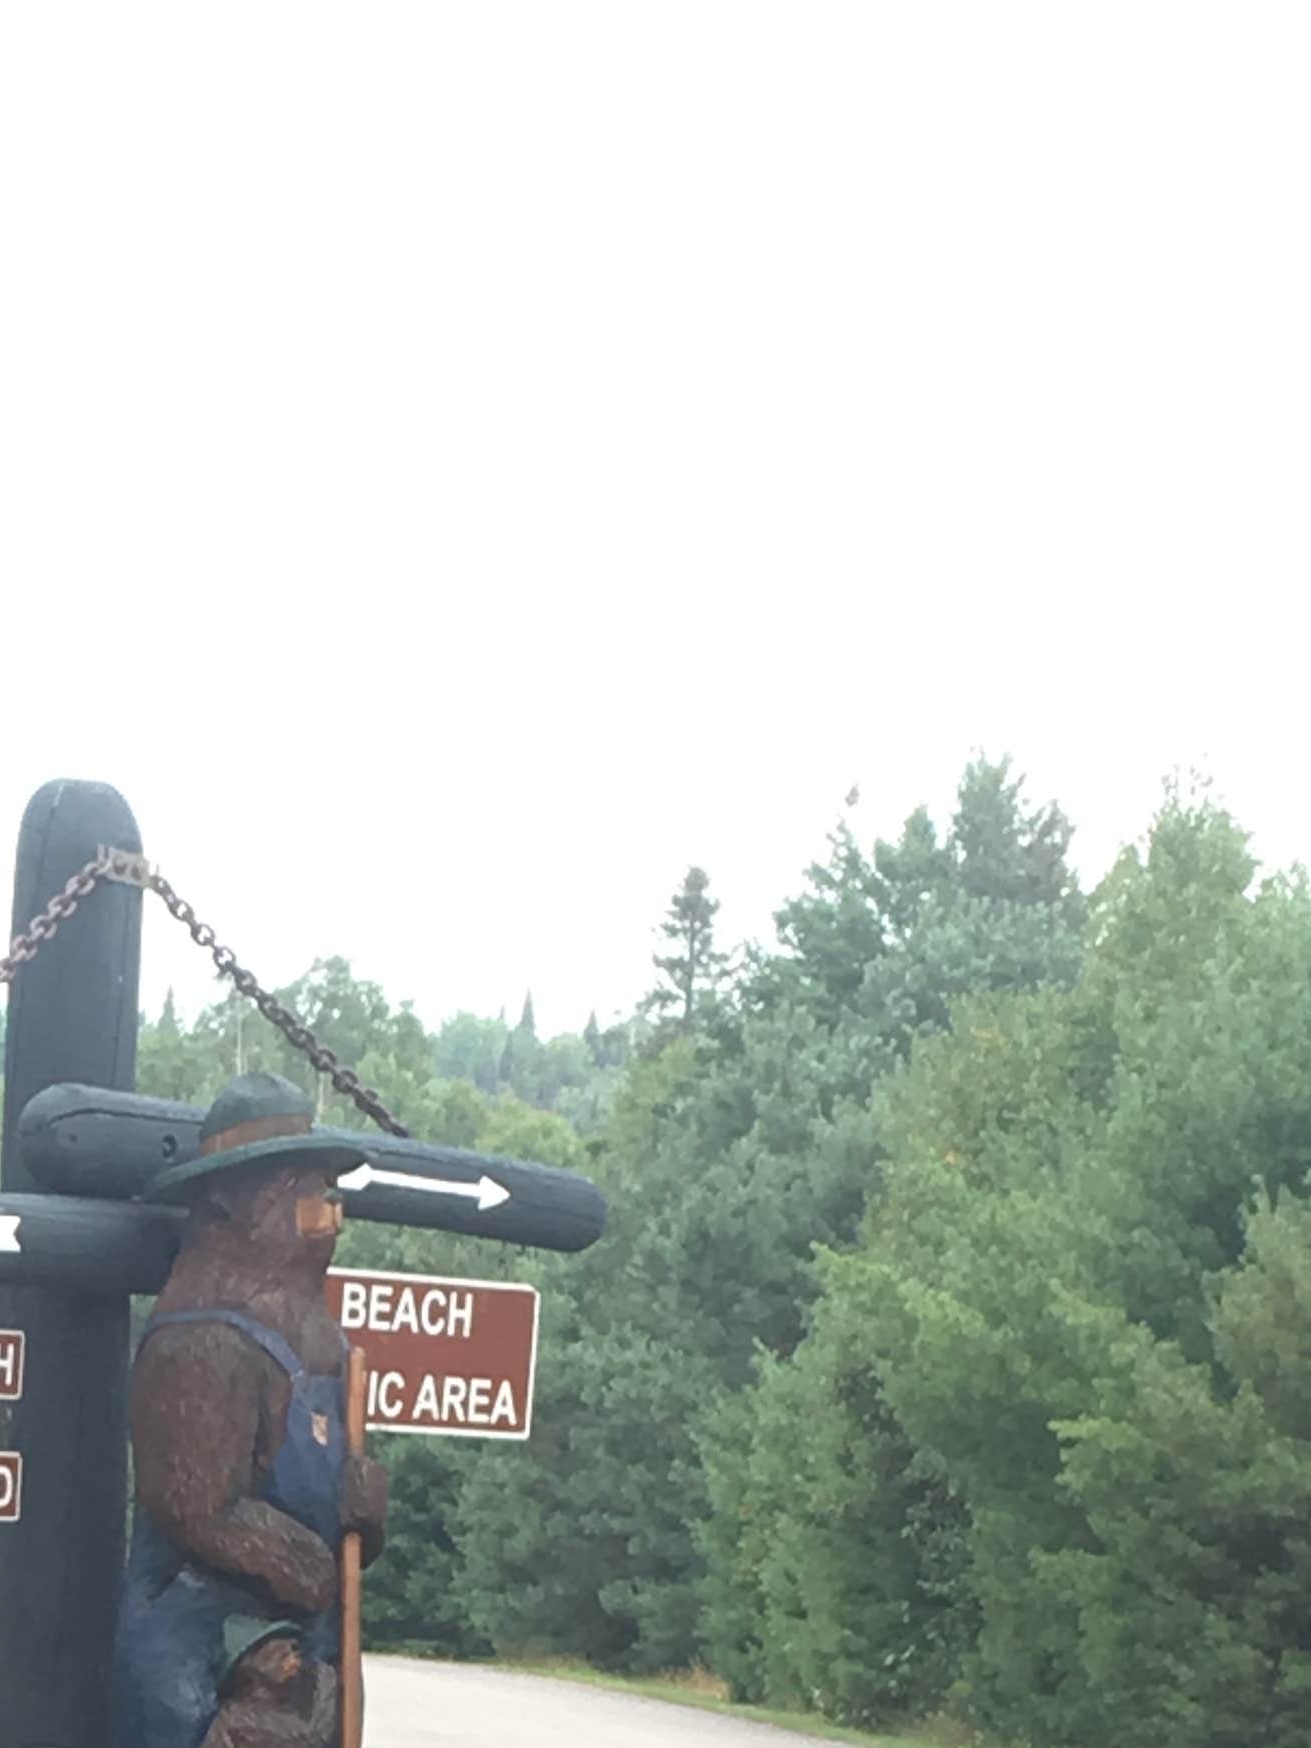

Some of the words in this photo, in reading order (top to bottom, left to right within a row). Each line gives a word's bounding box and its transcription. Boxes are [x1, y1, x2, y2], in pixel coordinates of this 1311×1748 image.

[341, 1282, 473, 1338] BEACH
[363, 1370, 405, 1418] IC
[412, 1374, 517, 1426] AREA
